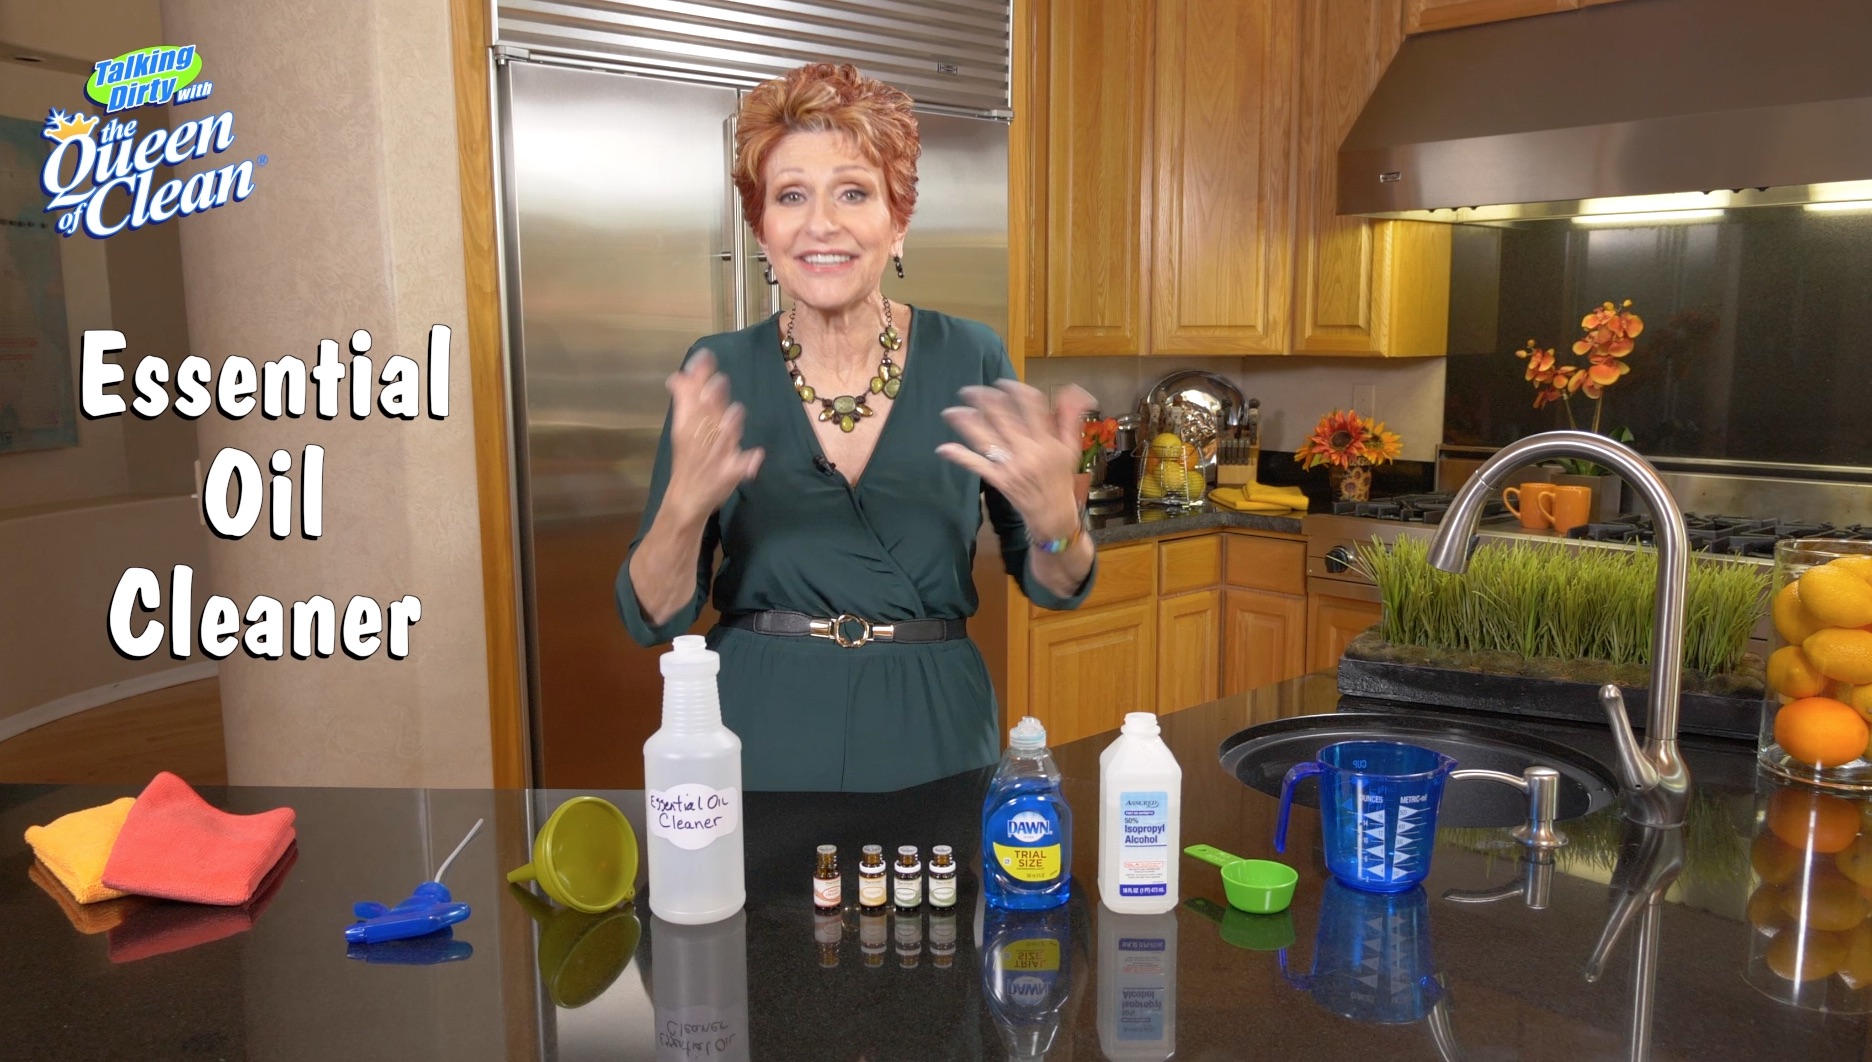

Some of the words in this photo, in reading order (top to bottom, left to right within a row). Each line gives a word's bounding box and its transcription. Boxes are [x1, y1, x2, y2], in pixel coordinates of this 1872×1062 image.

[650, 793, 703, 812] Essential
[659, 812, 723, 830] Cleaner
[1008, 820, 1050, 835] DAWN
[1124, 824, 1165, 835] Isopropyl
[1125, 834, 1158, 844] Alcohol
[1014, 850, 1047, 859] TRIAL
[1018, 859, 1043, 868] SIZE
